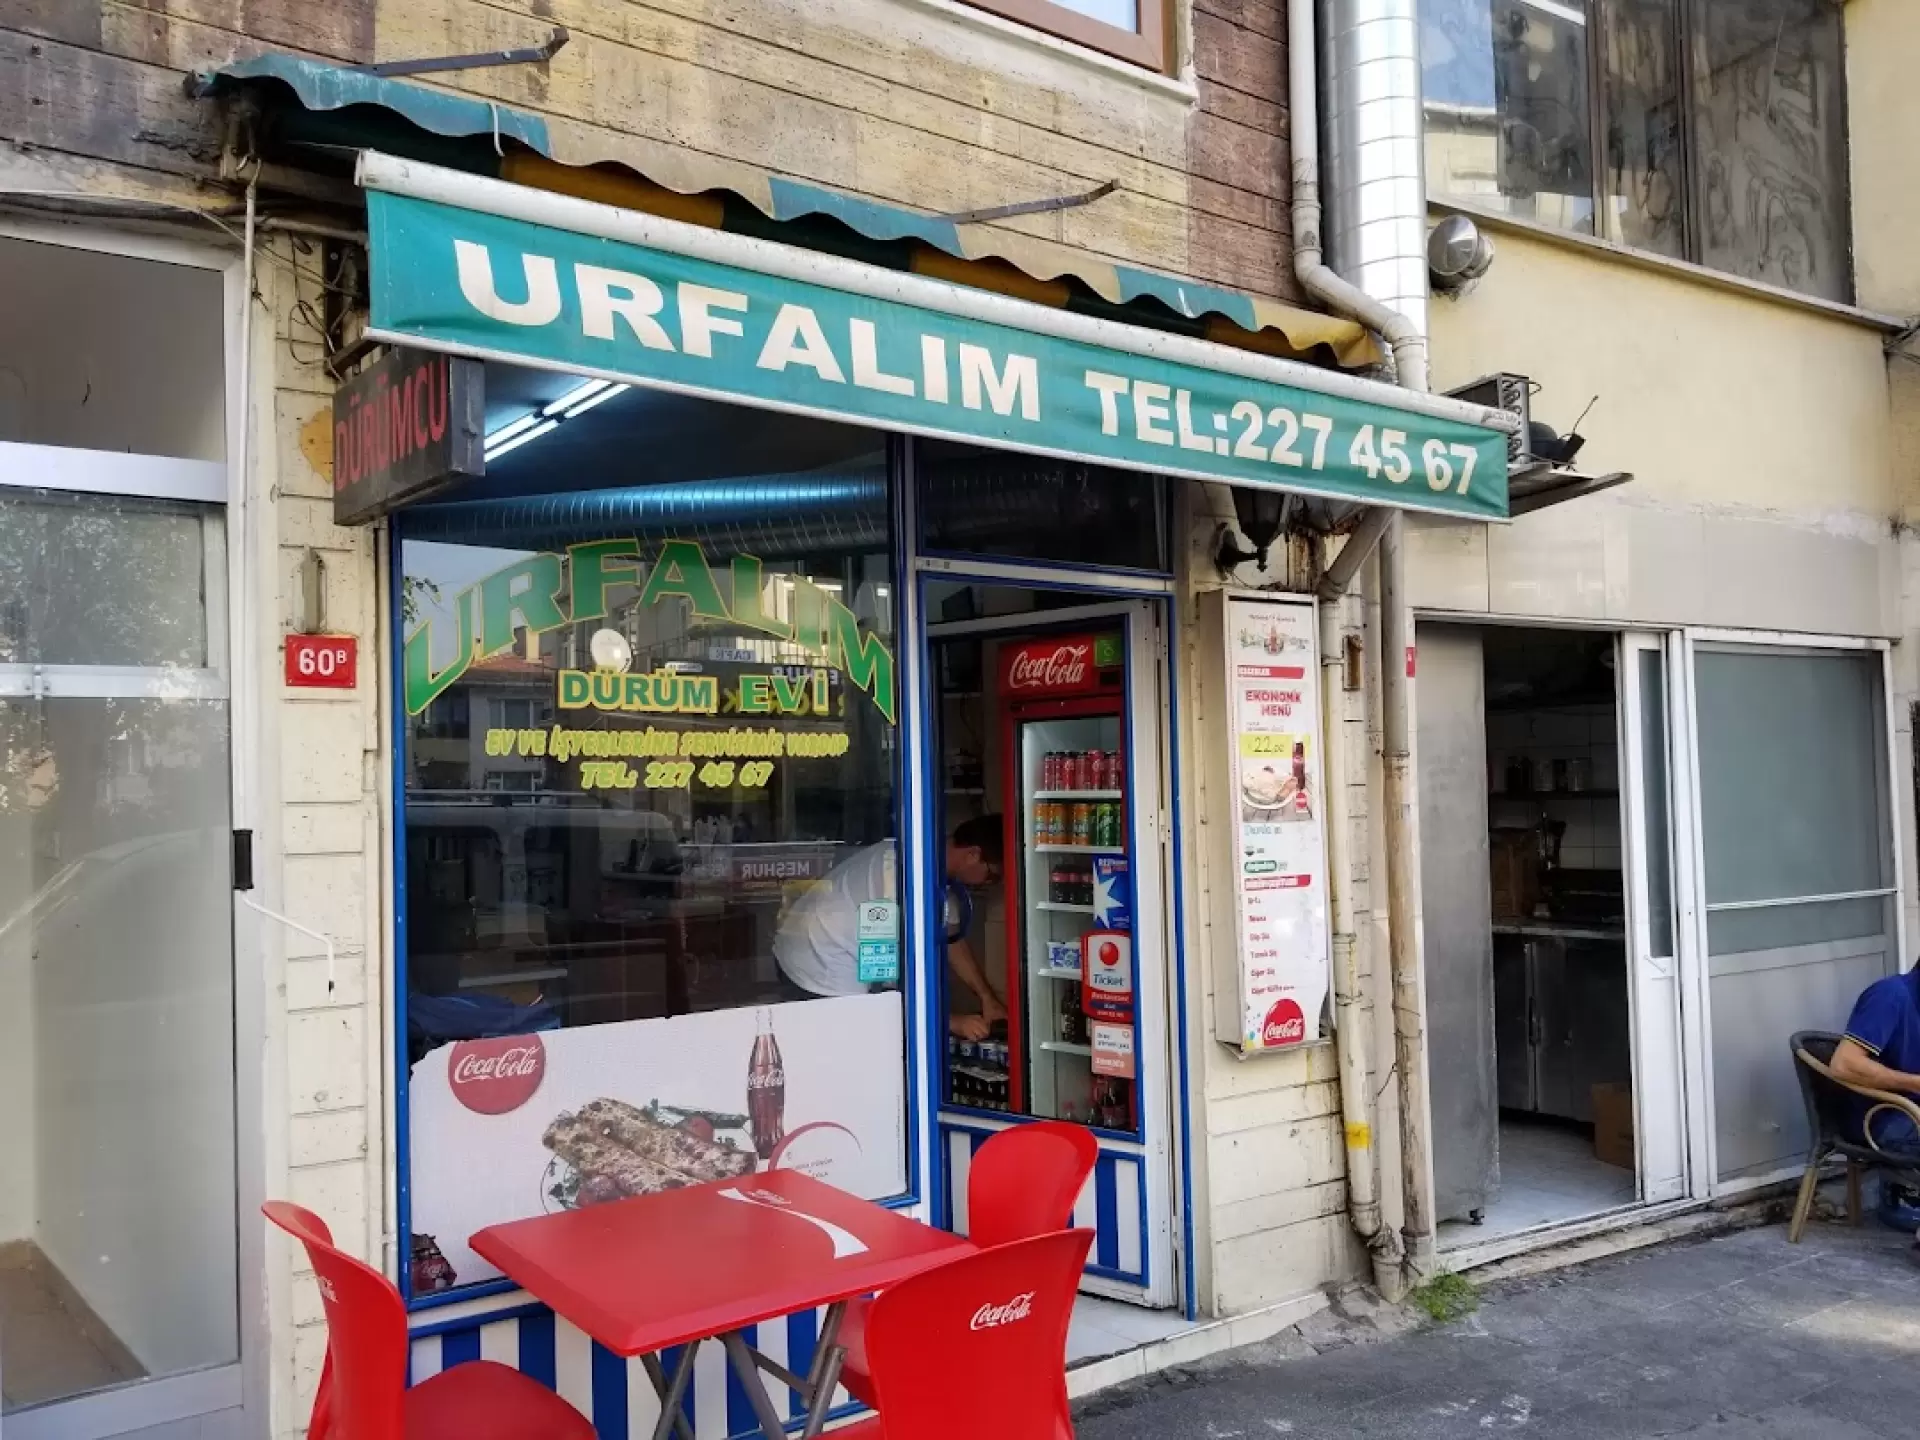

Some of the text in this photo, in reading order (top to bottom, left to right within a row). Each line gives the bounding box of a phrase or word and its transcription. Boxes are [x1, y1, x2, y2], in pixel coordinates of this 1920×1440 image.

[453, 239, 1041, 421] URFALIM
[1349, 424, 1413, 484] 45
[1422, 439, 1478, 495] 67
[405, 538, 896, 725] URFALIM
[557, 668, 718, 713] DÜRÜM
[739, 668, 829, 712] EVİ
[485, 729, 516, 756] EV
[518, 729, 547, 756] VE
[644, 761, 695, 789] 227
[699, 761, 735, 788] 45
[739, 761, 774, 788] 67
